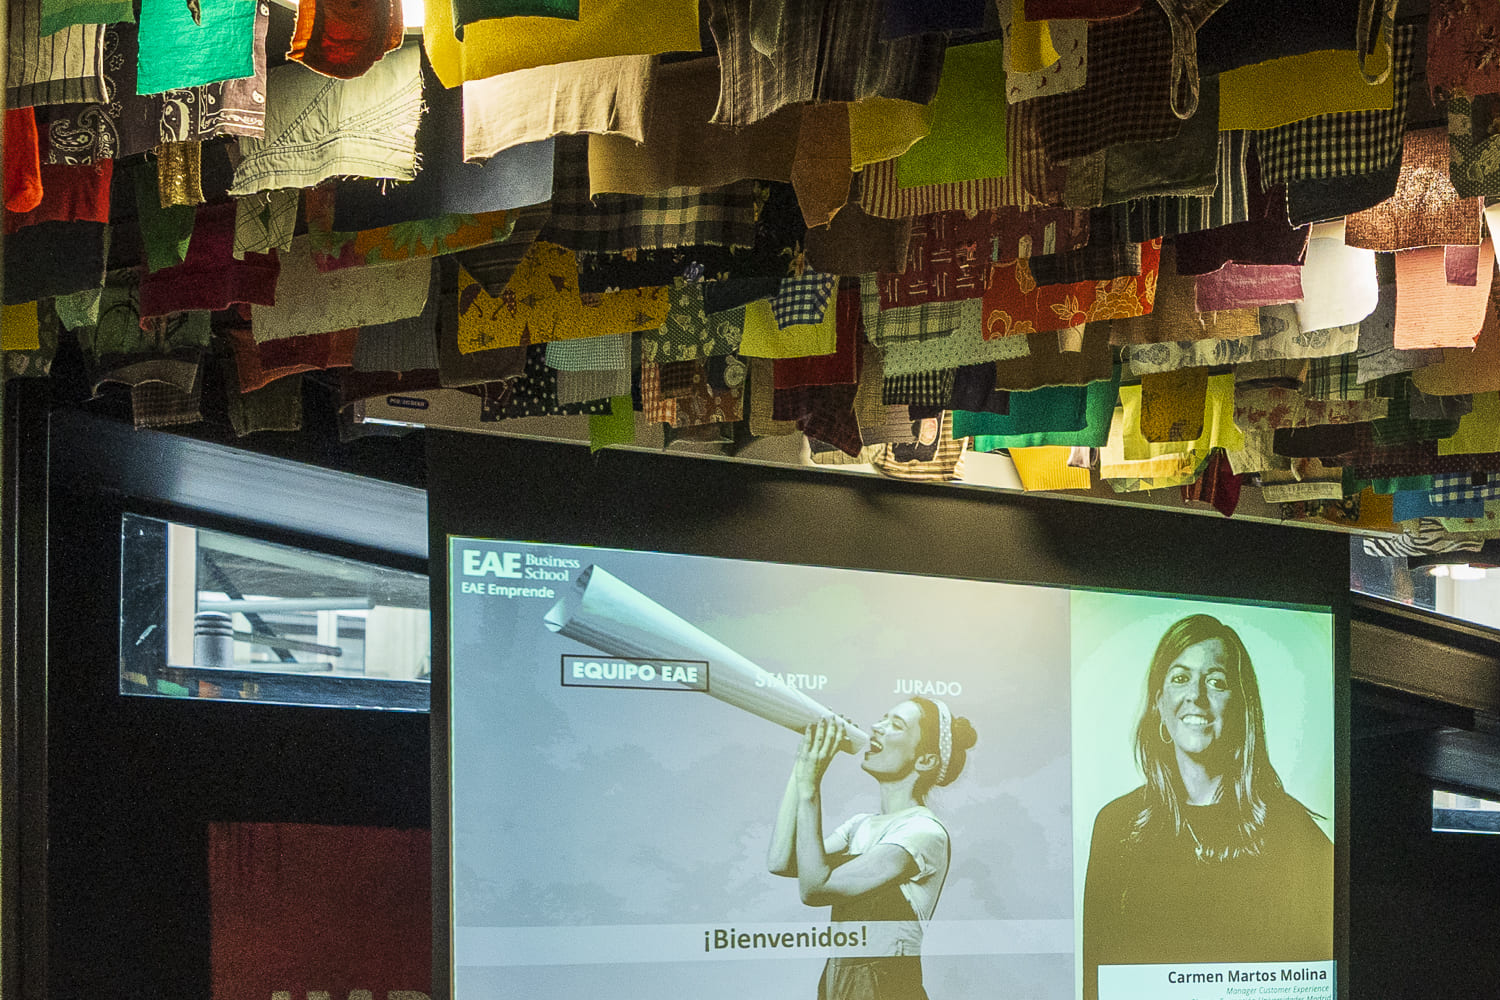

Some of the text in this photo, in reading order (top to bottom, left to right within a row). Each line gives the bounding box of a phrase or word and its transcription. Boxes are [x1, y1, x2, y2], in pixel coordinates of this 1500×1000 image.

[463, 549, 523, 579] EAE
[525, 553, 580, 569] Business
[525, 567, 569, 582] School
[461, 582, 555, 599] EAE Emprende
[572, 661, 698, 683] EQUIPO EAE
[755, 673, 828, 690] STARTUP
[894, 679, 962, 696] JURADO
[705, 925, 867, 952] ¡Bienvenidos!
[1168, 968, 1327, 984] Carmen Martos Molina
[1226, 984, 1329, 997] Manager Customer Experience
